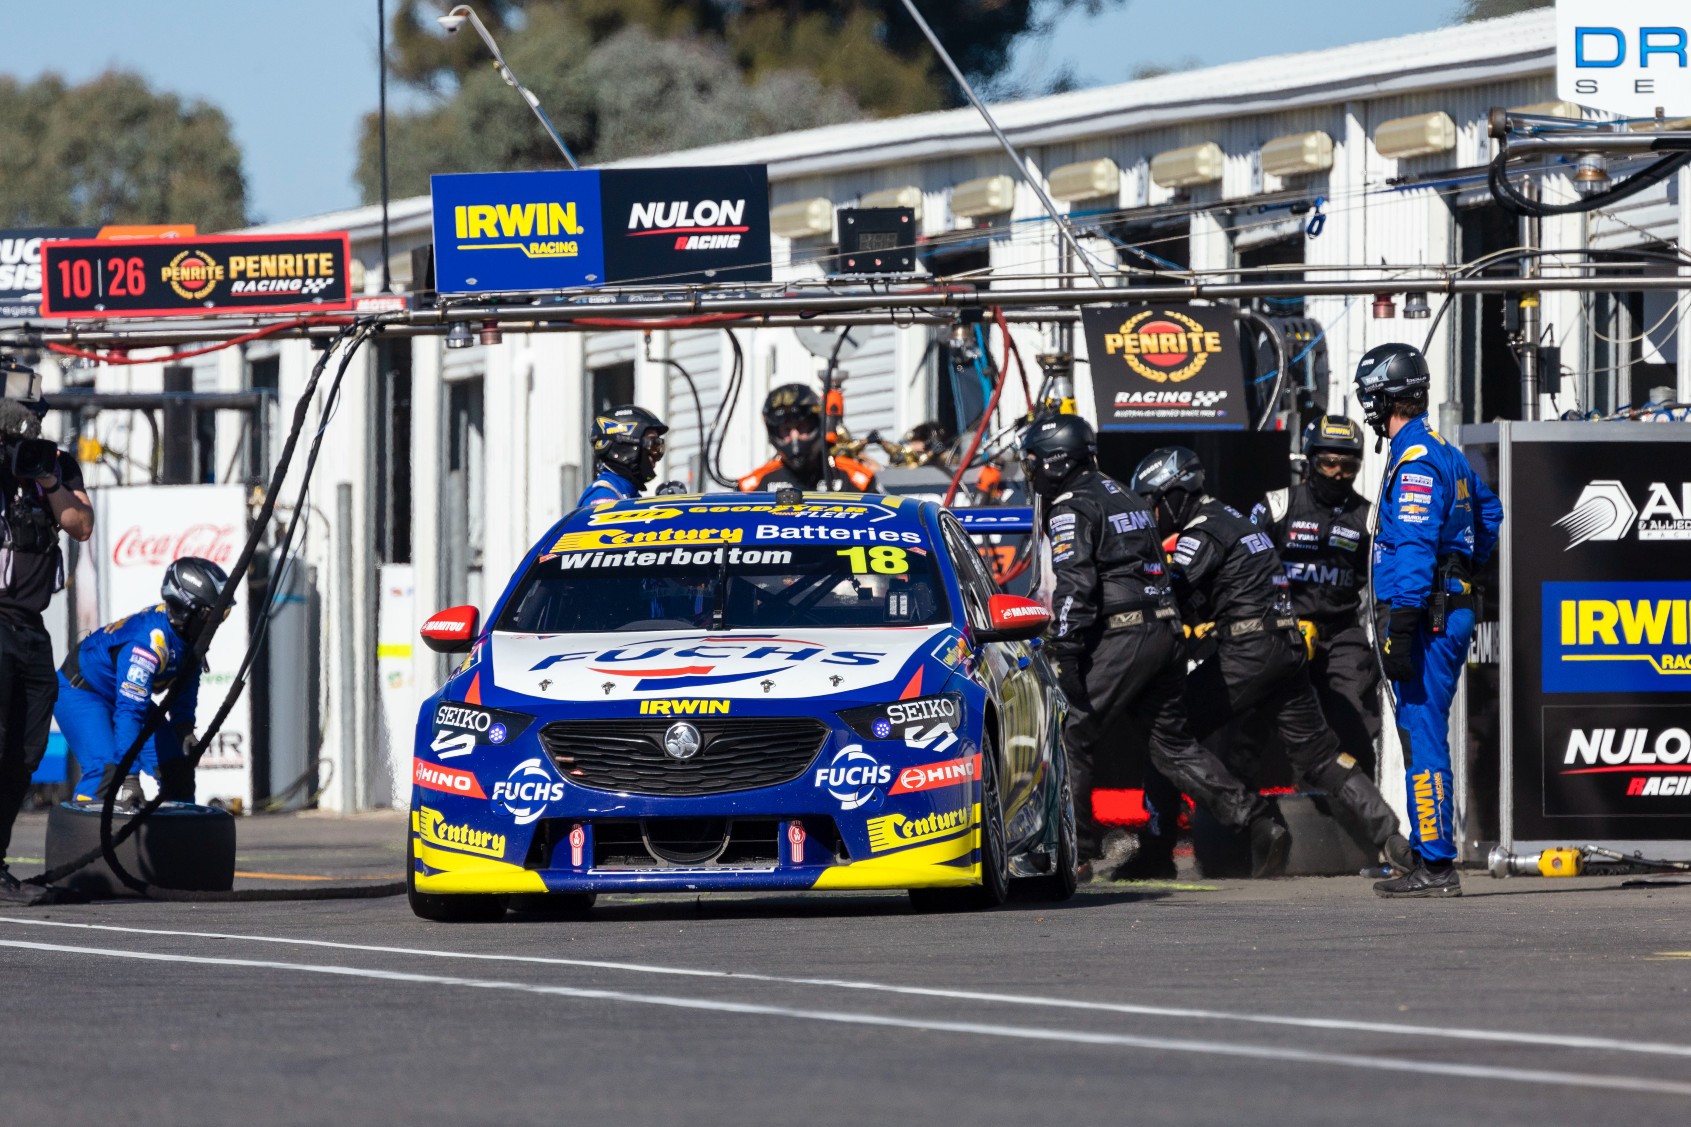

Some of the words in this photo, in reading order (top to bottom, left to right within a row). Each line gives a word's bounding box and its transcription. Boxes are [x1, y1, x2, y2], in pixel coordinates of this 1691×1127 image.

[627, 200, 746, 229] NULON
[530, 242, 578, 255] RACING
[673, 234, 740, 250] RACING
[161, 265, 225, 282] PENRITE
[229, 253, 334, 279] PENRITE
[58, 259, 92, 298] 10
[107, 257, 146, 296] 26
[231, 278, 302, 293] RACING
[1105, 332, 1222, 354] PENRITE
[1115, 391, 1193, 404] RACING
[755, 525, 922, 543] Batteries
[560, 547, 792, 569] Winterbottom
[836, 545, 909, 574] 18
[1282, 562, 1339, 586] TEAM
[425, 621, 466, 632] MANITOU
[1561, 600, 1691, 646] IRWI
[528, 645, 888, 672] FUCHS
[640, 700, 730, 714] IRWIN
[887, 698, 954, 725] SEIKO
[436, 705, 491, 732] SEIKO
[1564, 727, 1691, 765] NULO
[423, 768, 471, 791] HINO
[814, 766, 892, 787] FUCHS
[928, 762, 974, 783] HINO
[491, 782, 564, 802] FUCHS
[431, 814, 506, 850] Century
